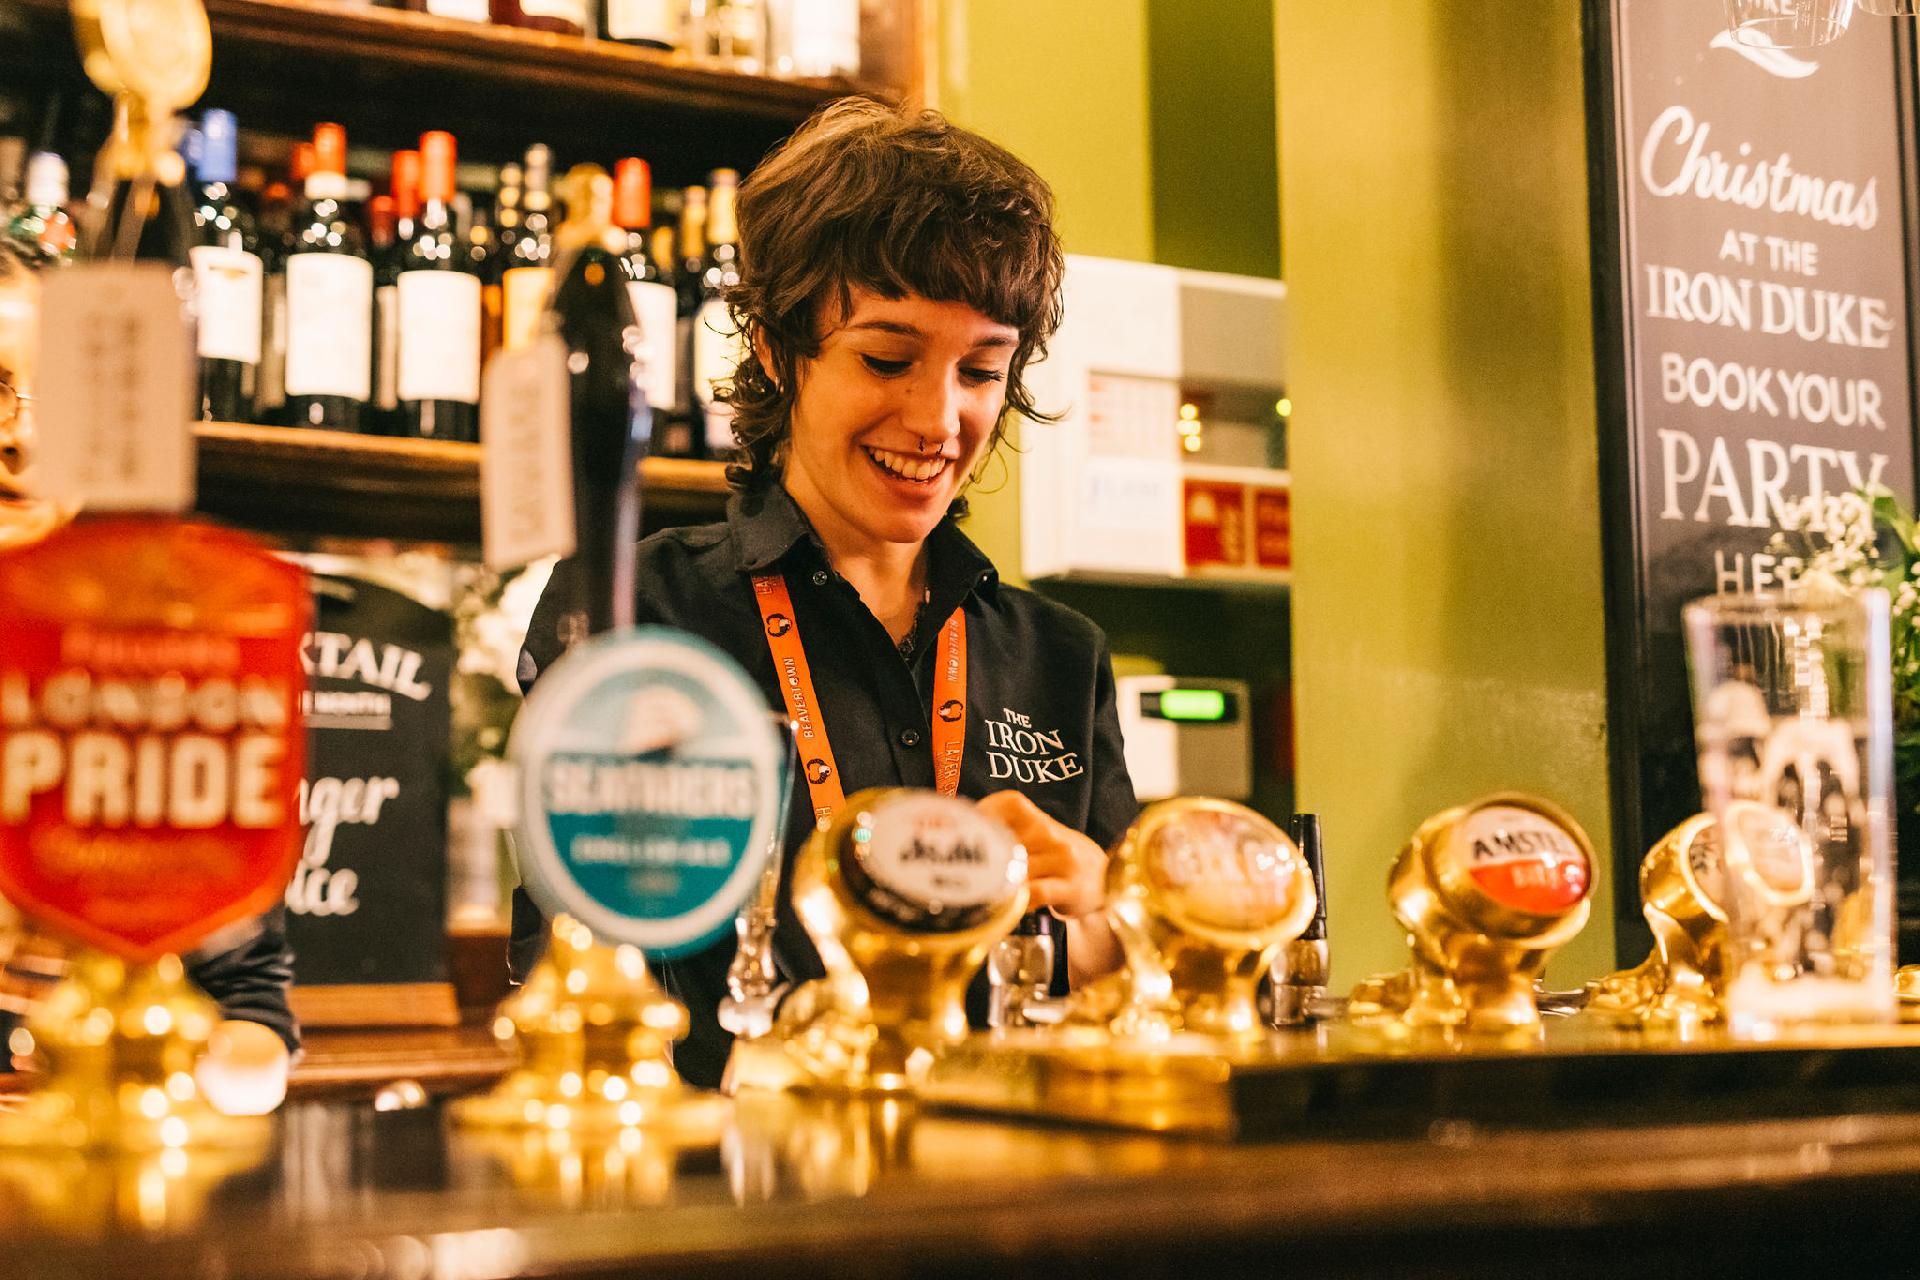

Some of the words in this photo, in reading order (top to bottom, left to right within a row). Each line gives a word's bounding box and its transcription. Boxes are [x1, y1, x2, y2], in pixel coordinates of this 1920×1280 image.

[1640, 105, 1879, 230] Christmas
[1719, 230, 1758, 266] AT
[1765, 235, 1818, 276] THE
[1644, 264, 1756, 331] IRON
[1759, 280, 1895, 348] DUKE
[1660, 352, 1779, 417] BOOK
[1778, 369, 1887, 430] YOUR
[1657, 428, 1889, 532] PARTY
[1714, 550, 1812, 603] HER
[985, 719, 1065, 755] IRON
[1003, 707, 1033, 729] THE
[1, 730, 286, 830] PRIDE
[986, 752, 1084, 784] DUKE
